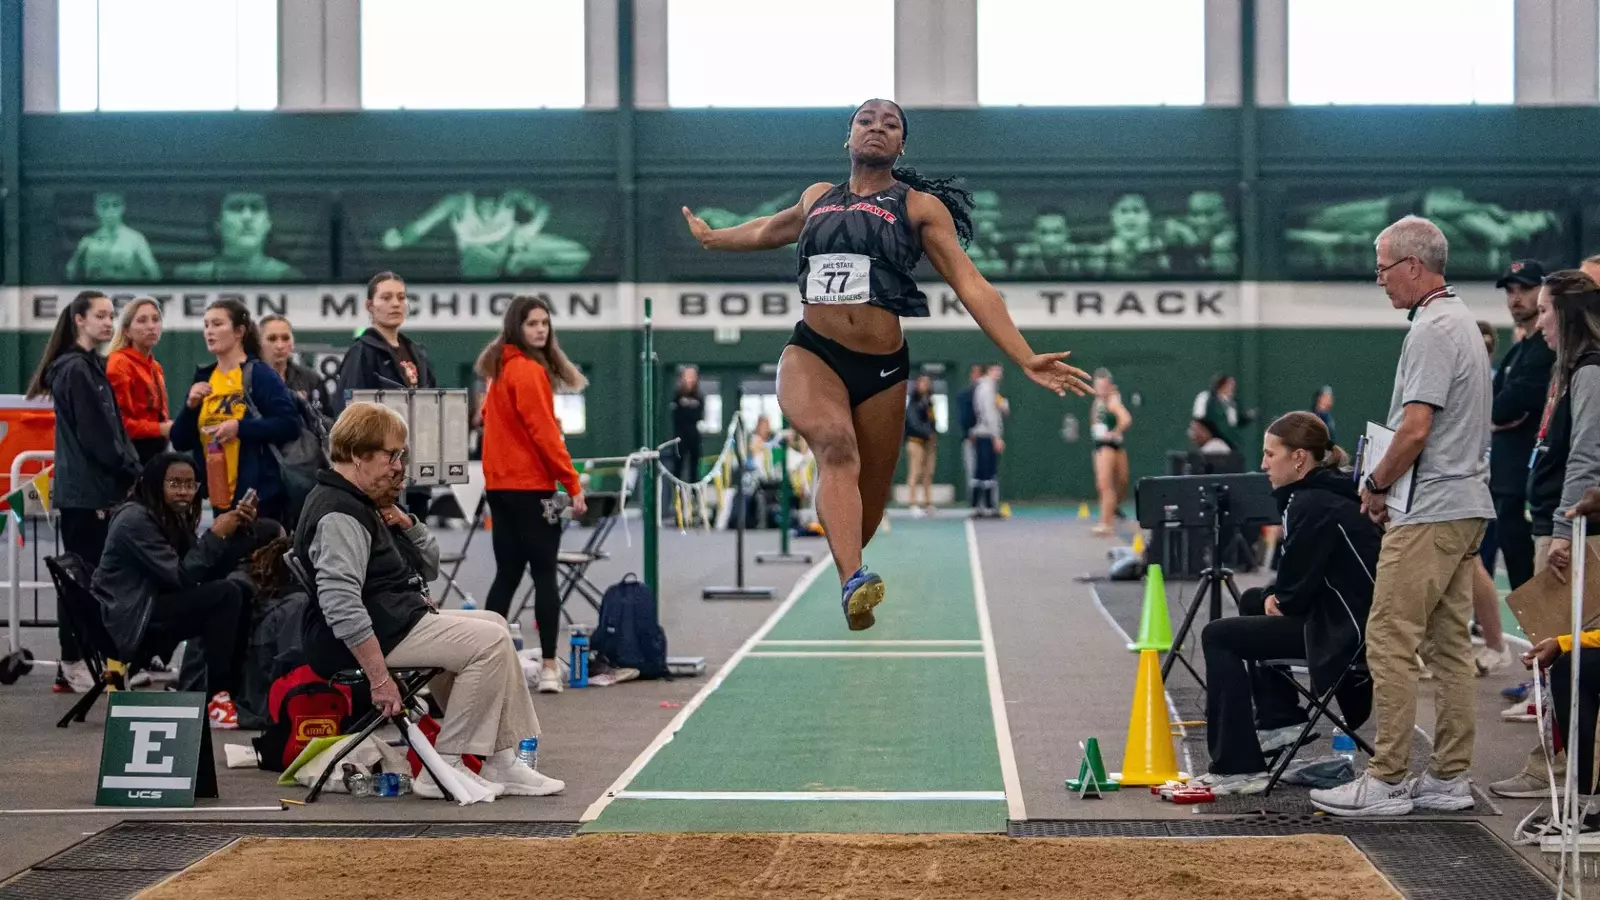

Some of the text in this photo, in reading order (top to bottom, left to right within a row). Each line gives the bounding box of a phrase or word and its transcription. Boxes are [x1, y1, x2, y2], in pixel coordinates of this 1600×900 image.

[847, 202, 897, 225] STATE
[824, 271, 850, 293] 77
[679, 292, 789, 316] BOB
[1038, 291, 1224, 316] TRACK
[838, 294, 862, 302] ROGERS
[124, 721, 178, 773] E
[128, 790, 162, 799] UCS
[1388, 787, 1408, 799] HOKA
